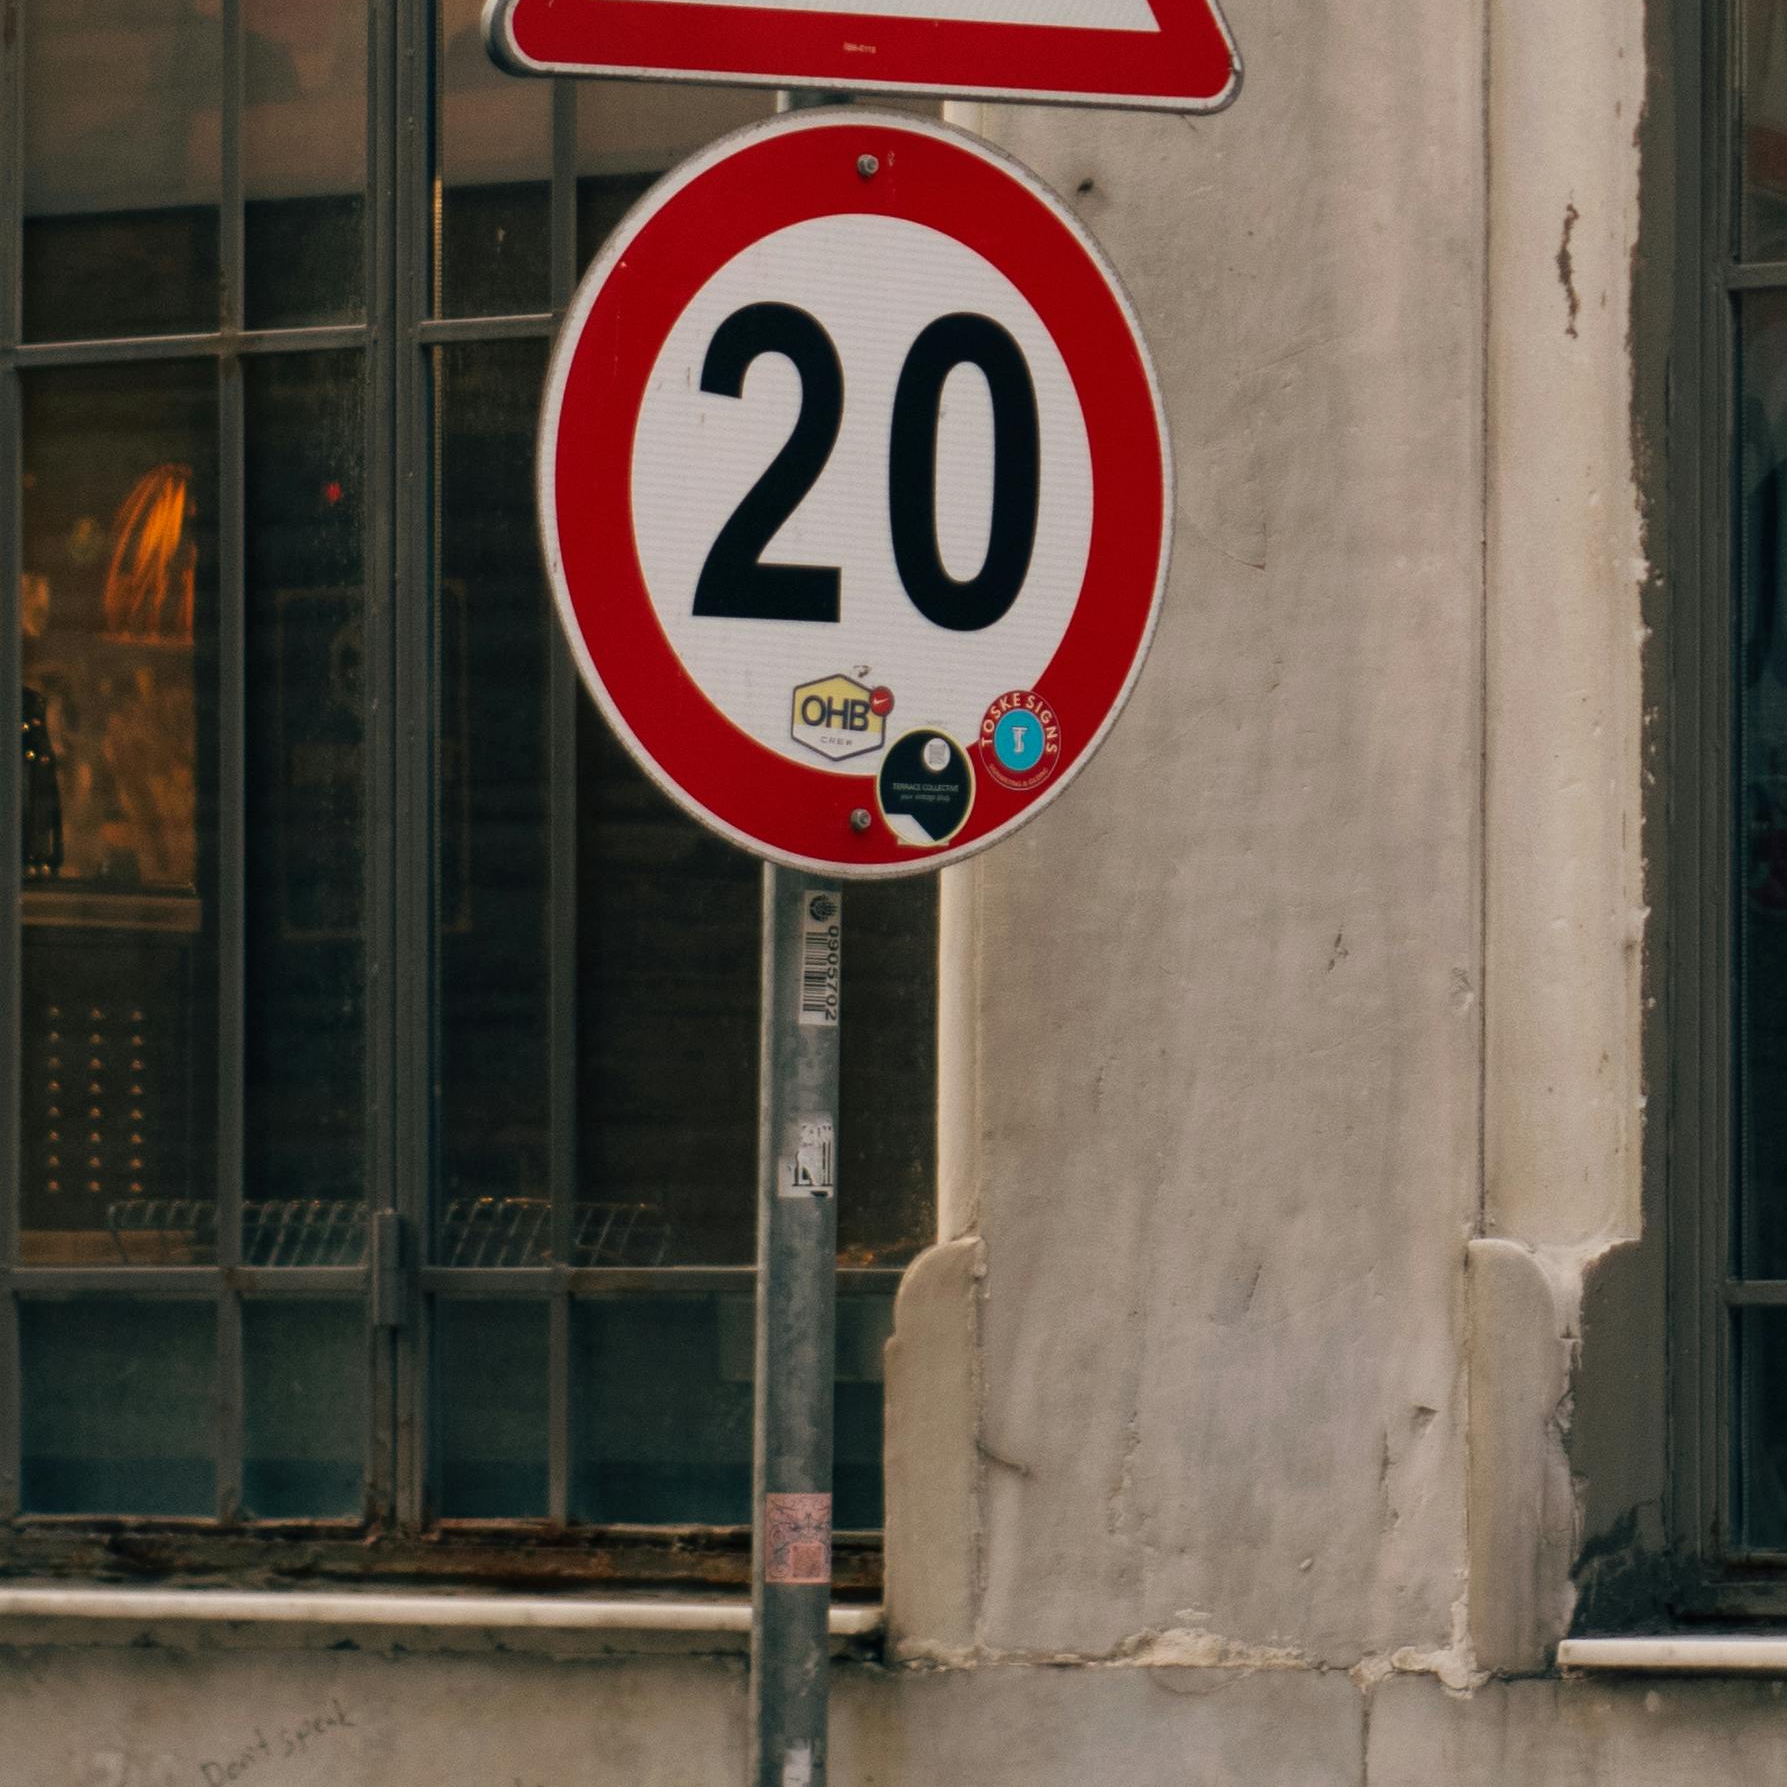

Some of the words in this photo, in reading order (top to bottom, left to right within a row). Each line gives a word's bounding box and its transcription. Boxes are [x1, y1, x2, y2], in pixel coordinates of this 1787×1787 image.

[692, 301, 1041, 631] 20
[802, 694, 870, 731] OHB
[982, 693, 1021, 747] TOSKE
[1025, 695, 1058, 753] SIGNS
[922, 784, 959, 792] COLLECTIVE
[825, 925, 839, 1021] 0905702
